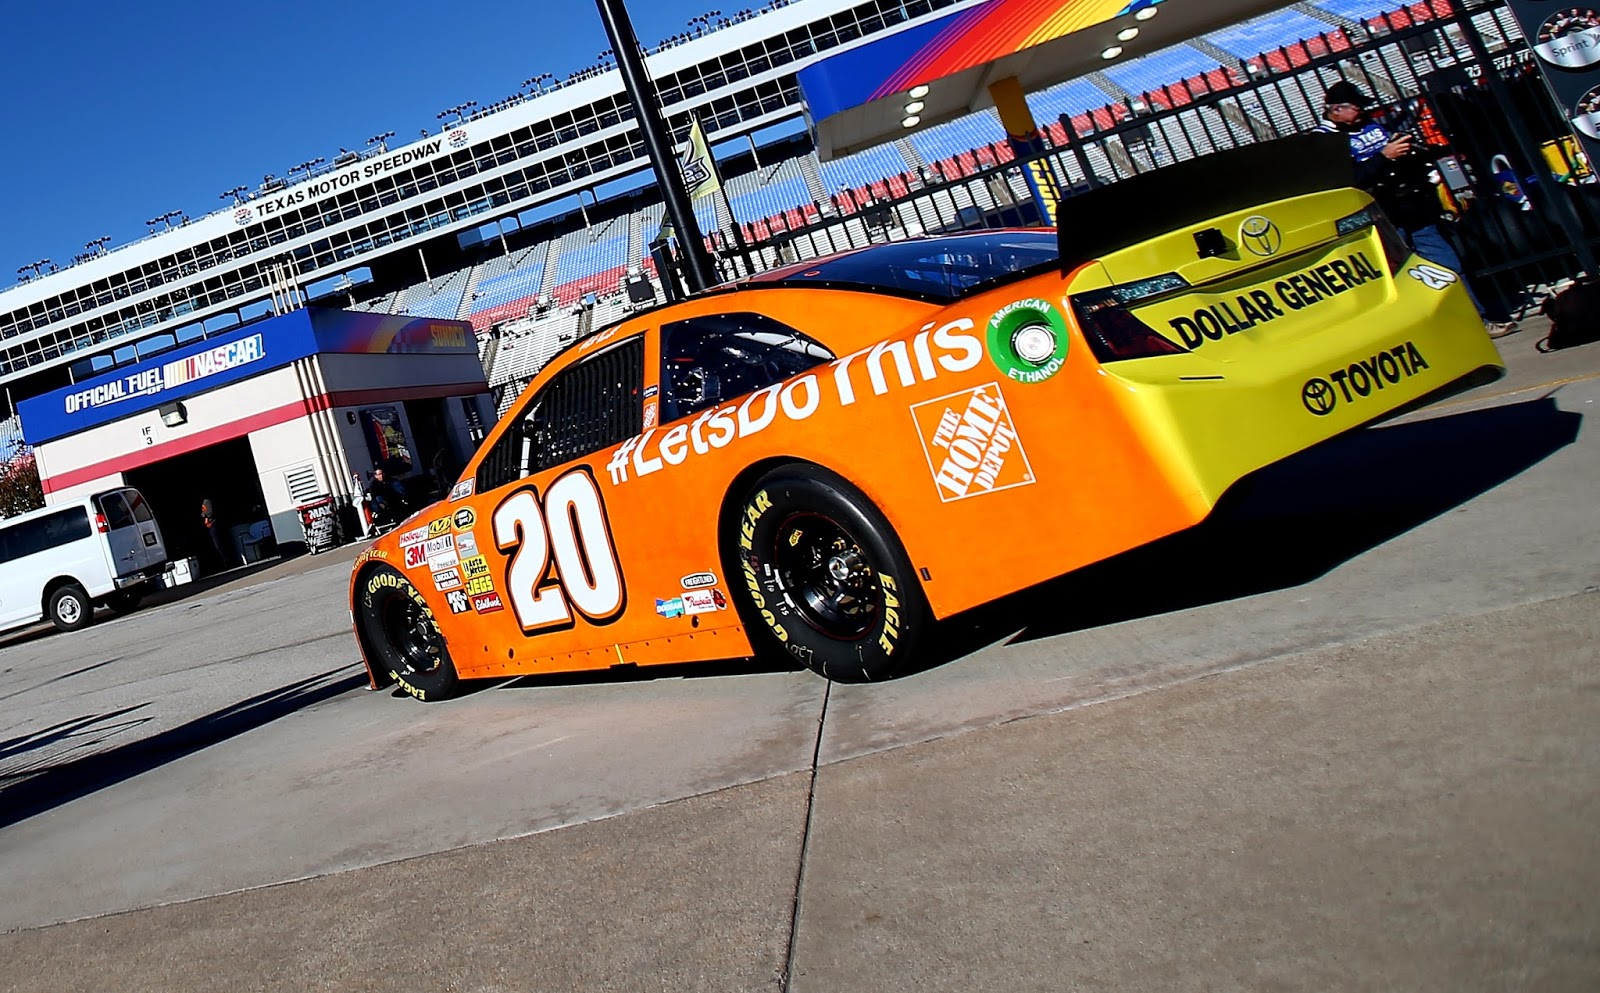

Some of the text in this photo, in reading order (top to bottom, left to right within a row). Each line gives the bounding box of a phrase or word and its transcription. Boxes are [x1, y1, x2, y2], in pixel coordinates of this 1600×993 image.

[1552, 40, 1589, 58] Sprint
[256, 190, 305, 217] TEXAS
[308, 171, 361, 200] MOTOR
[364, 139, 442, 178] SPEEDWAY
[1408, 265, 1457, 290] 20
[989, 298, 1051, 328] AMERICAN
[1169, 252, 1383, 350] DOLLAR GENERAL
[430, 325, 466, 347] SUNOCO
[147, 334, 264, 395] OF NASCAR
[1008, 356, 1065, 383] ETHANOL
[1333, 341, 1429, 403] TOYOTA
[65, 367, 163, 414] OFFICIAL FUEL
[142, 426, 152, 437] IF
[146, 437, 153, 446] 3
[931, 407, 962, 450] THE
[936, 386, 1005, 497] HOME
[974, 421, 1016, 491] DEPOT
[400, 532, 420, 544] Holley
[427, 539, 444, 552] Mobil
[492, 467, 625, 634] 20
[407, 542, 426, 566] 3M
[437, 559, 456, 569] freescale
[469, 558, 482, 569] Auto
[467, 576, 493, 596] JEGS
[878, 571, 901, 656] EAGLE
[389, 670, 426, 701] EAGLE
